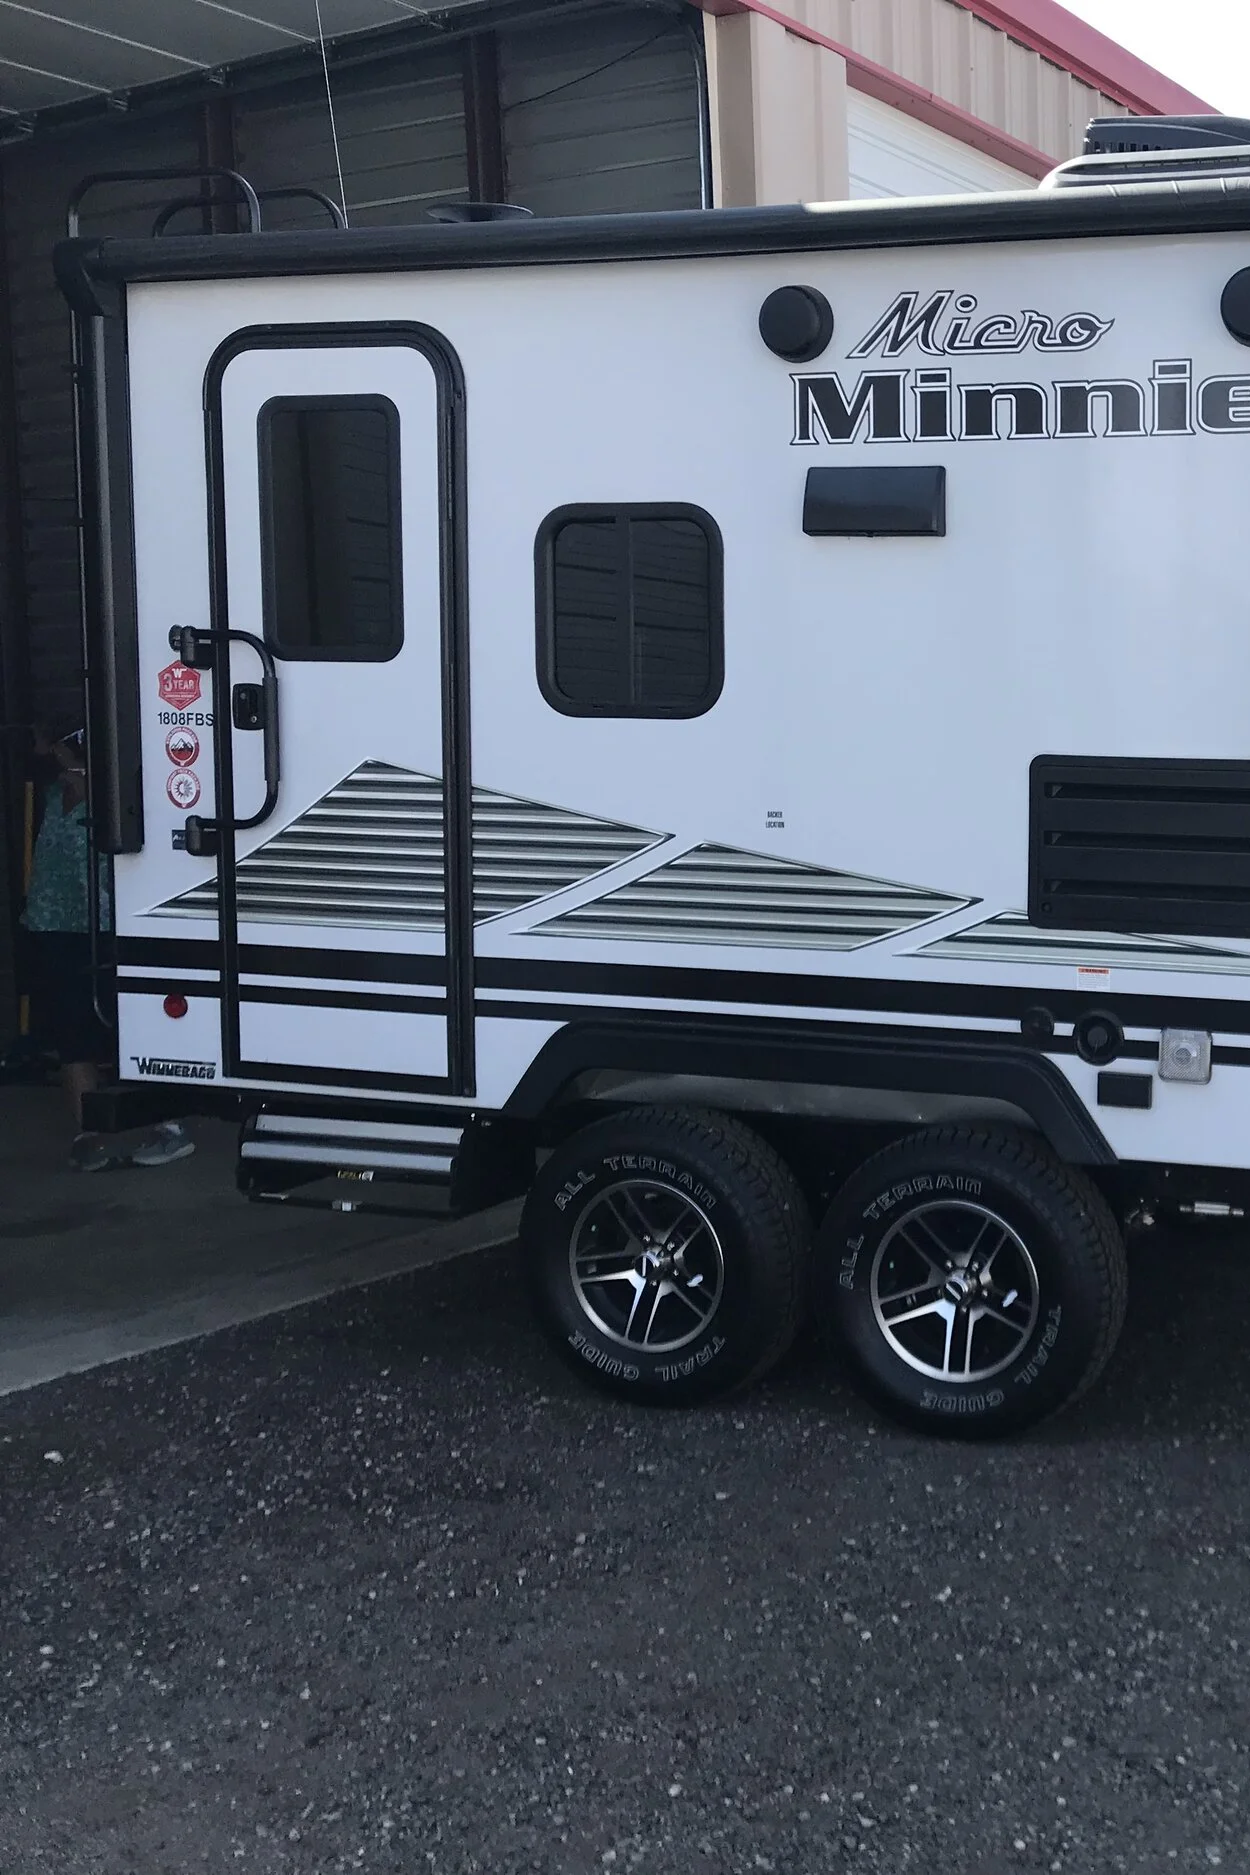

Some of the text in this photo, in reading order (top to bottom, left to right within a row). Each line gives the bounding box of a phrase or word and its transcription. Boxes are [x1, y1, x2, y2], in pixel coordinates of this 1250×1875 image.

[845, 289, 1115, 359] Micro
[163, 673, 195, 692] 3 YEAR
[157, 711, 214, 727] 1808FBS
[130, 1057, 216, 1080] WINNEBAGO
[554, 1155, 718, 1211] ALL TERRAIN
[839, 1175, 983, 1290] ALL TERRAIN
[567, 1329, 727, 1382] TRAIL GUIDE
[919, 1304, 1062, 1414] TRAIL GUIDE
